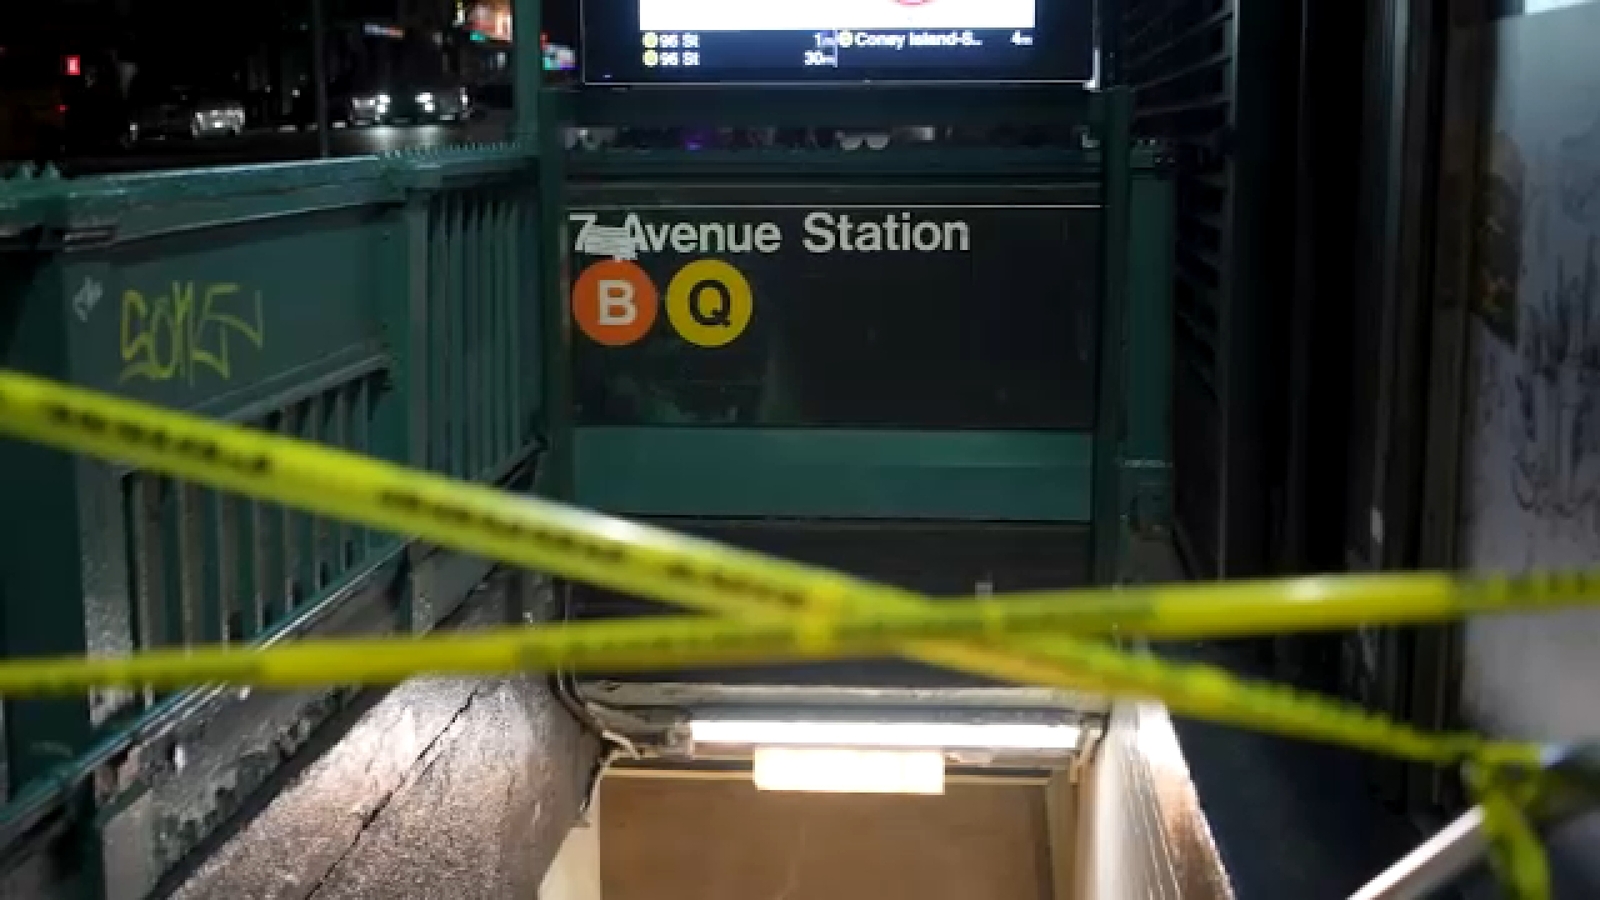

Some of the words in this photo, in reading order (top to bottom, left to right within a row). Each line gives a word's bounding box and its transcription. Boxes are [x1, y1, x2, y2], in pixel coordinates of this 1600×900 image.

[854, 32, 906, 50] Coney
[620, 212, 783, 254] Avenue
[803, 211, 970, 254] Station
[597, 279, 639, 326] B
[688, 279, 732, 328] Q
